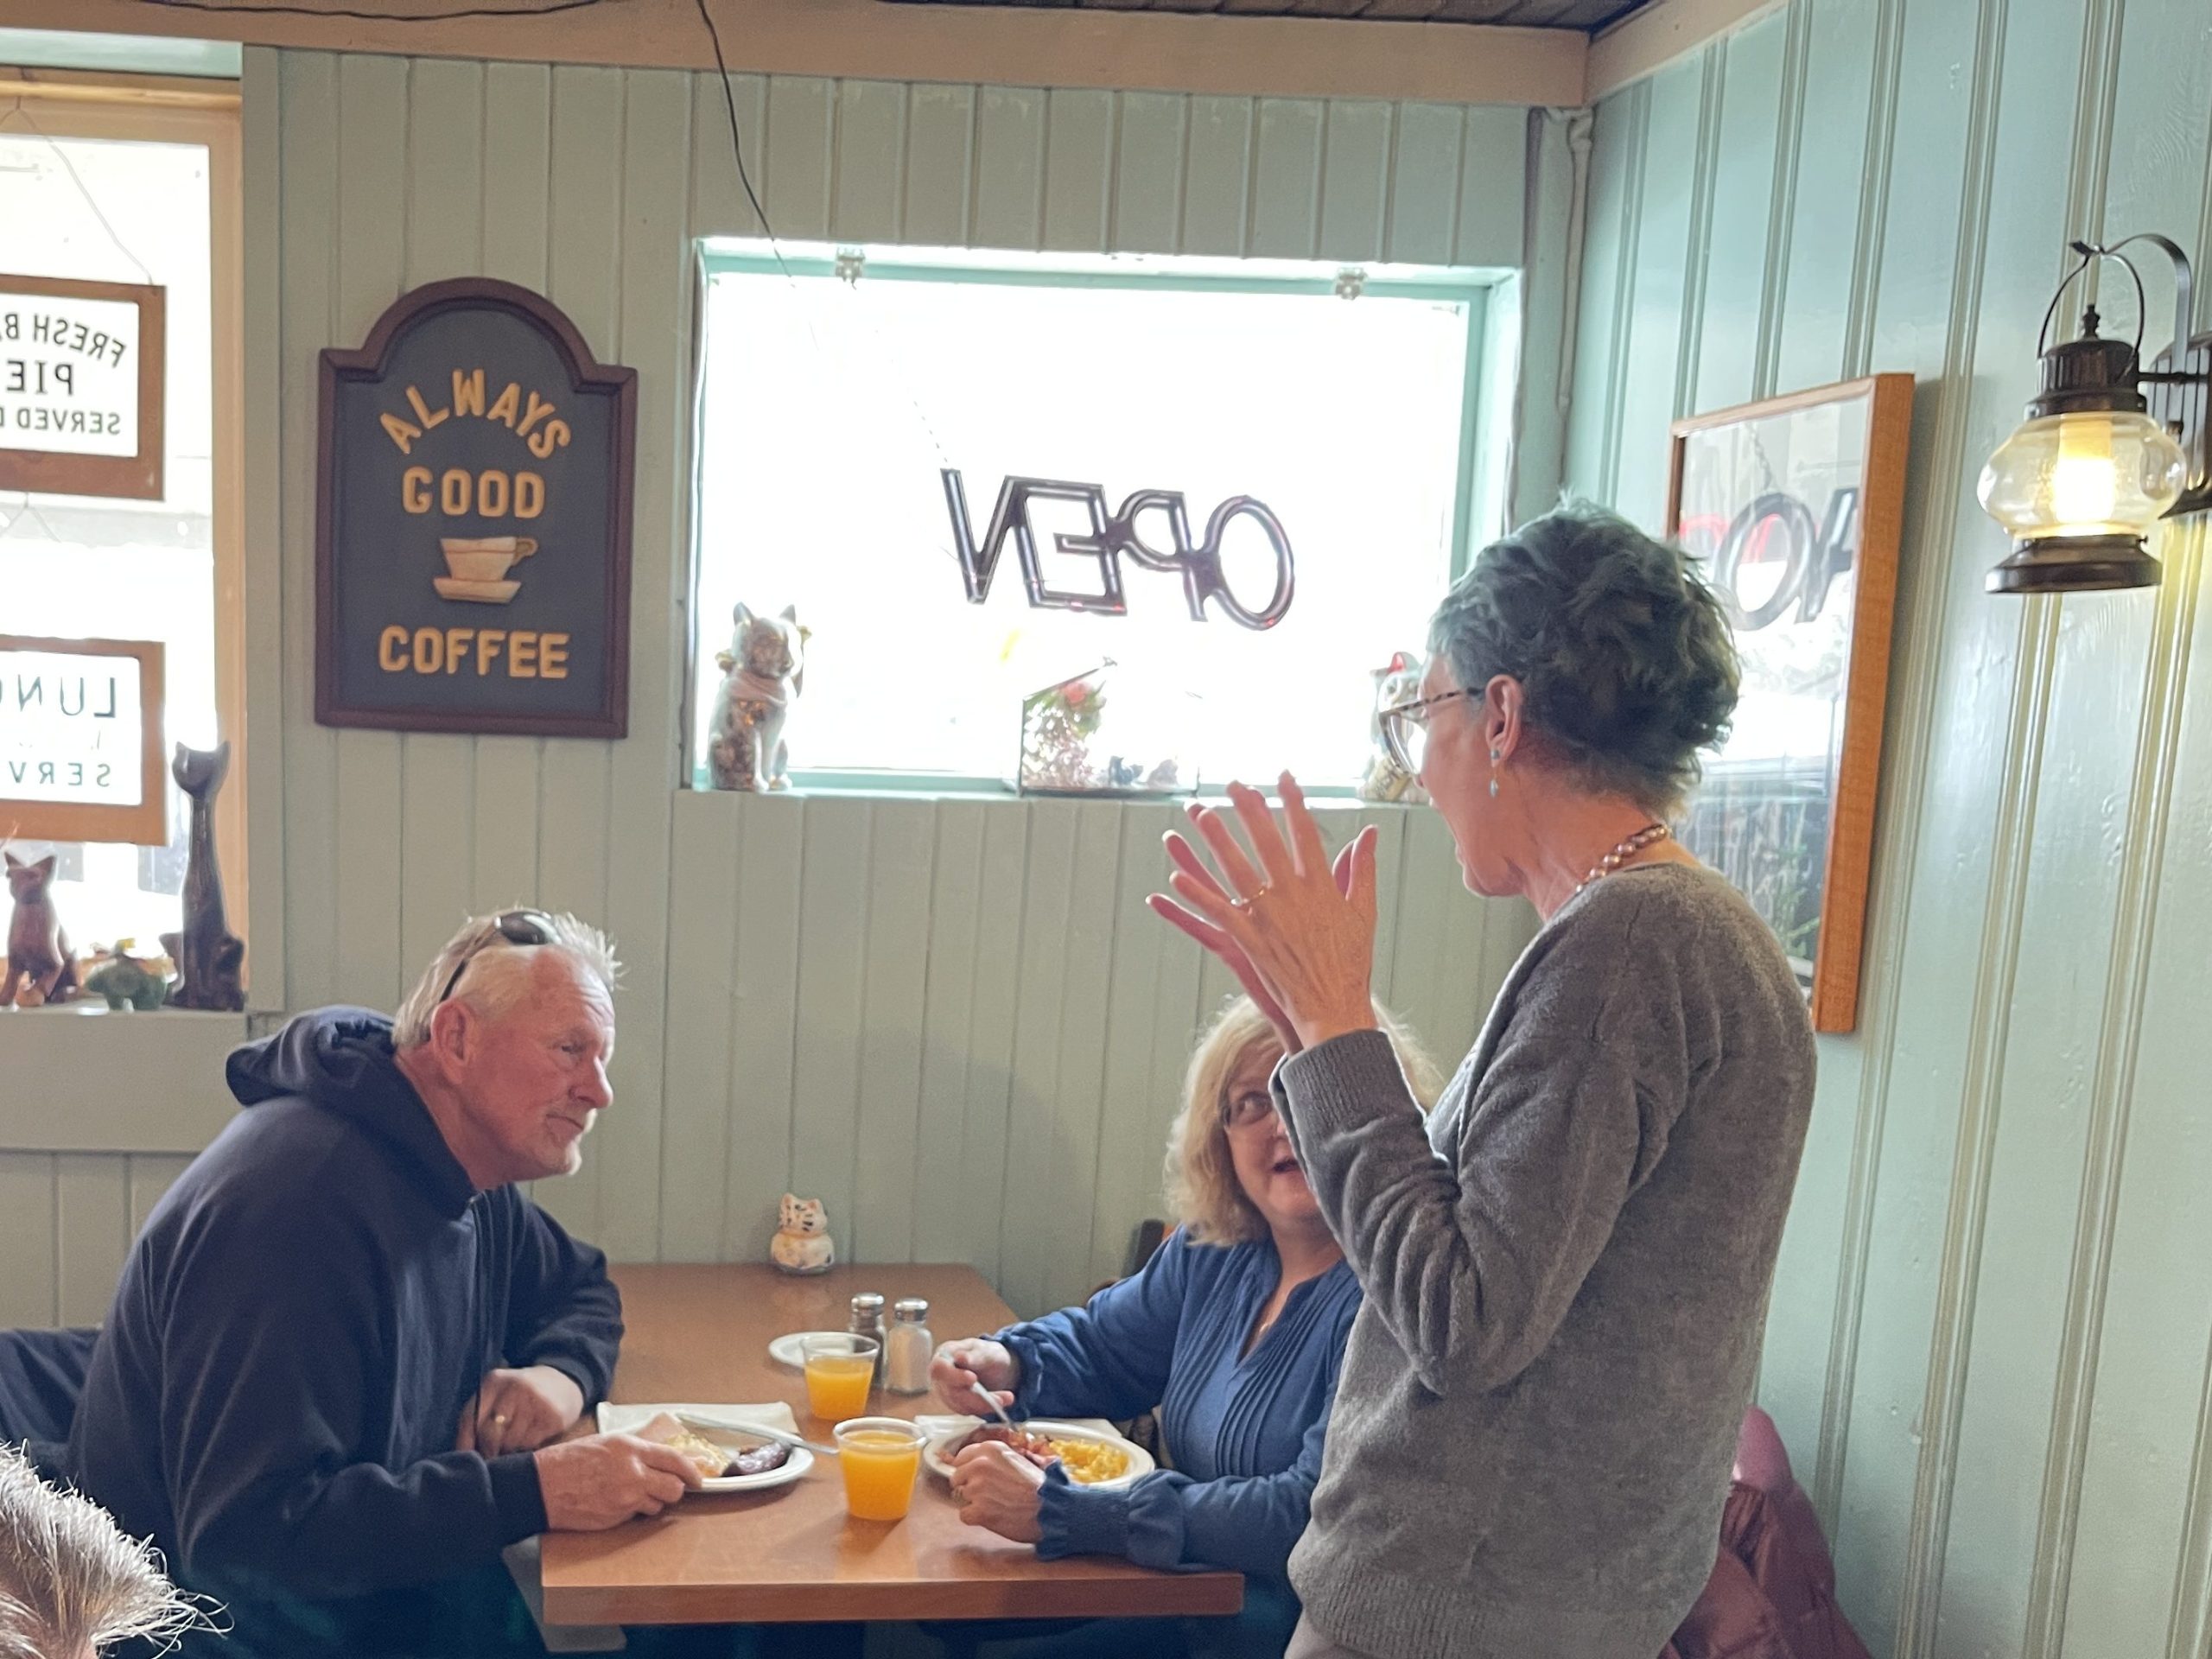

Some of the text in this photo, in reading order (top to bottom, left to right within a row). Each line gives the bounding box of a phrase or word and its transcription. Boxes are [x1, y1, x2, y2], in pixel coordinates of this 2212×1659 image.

[380, 368, 571, 459] ALWAYS
[403, 466, 545, 518] GOOD
[378, 626, 569, 679] COFFEE
